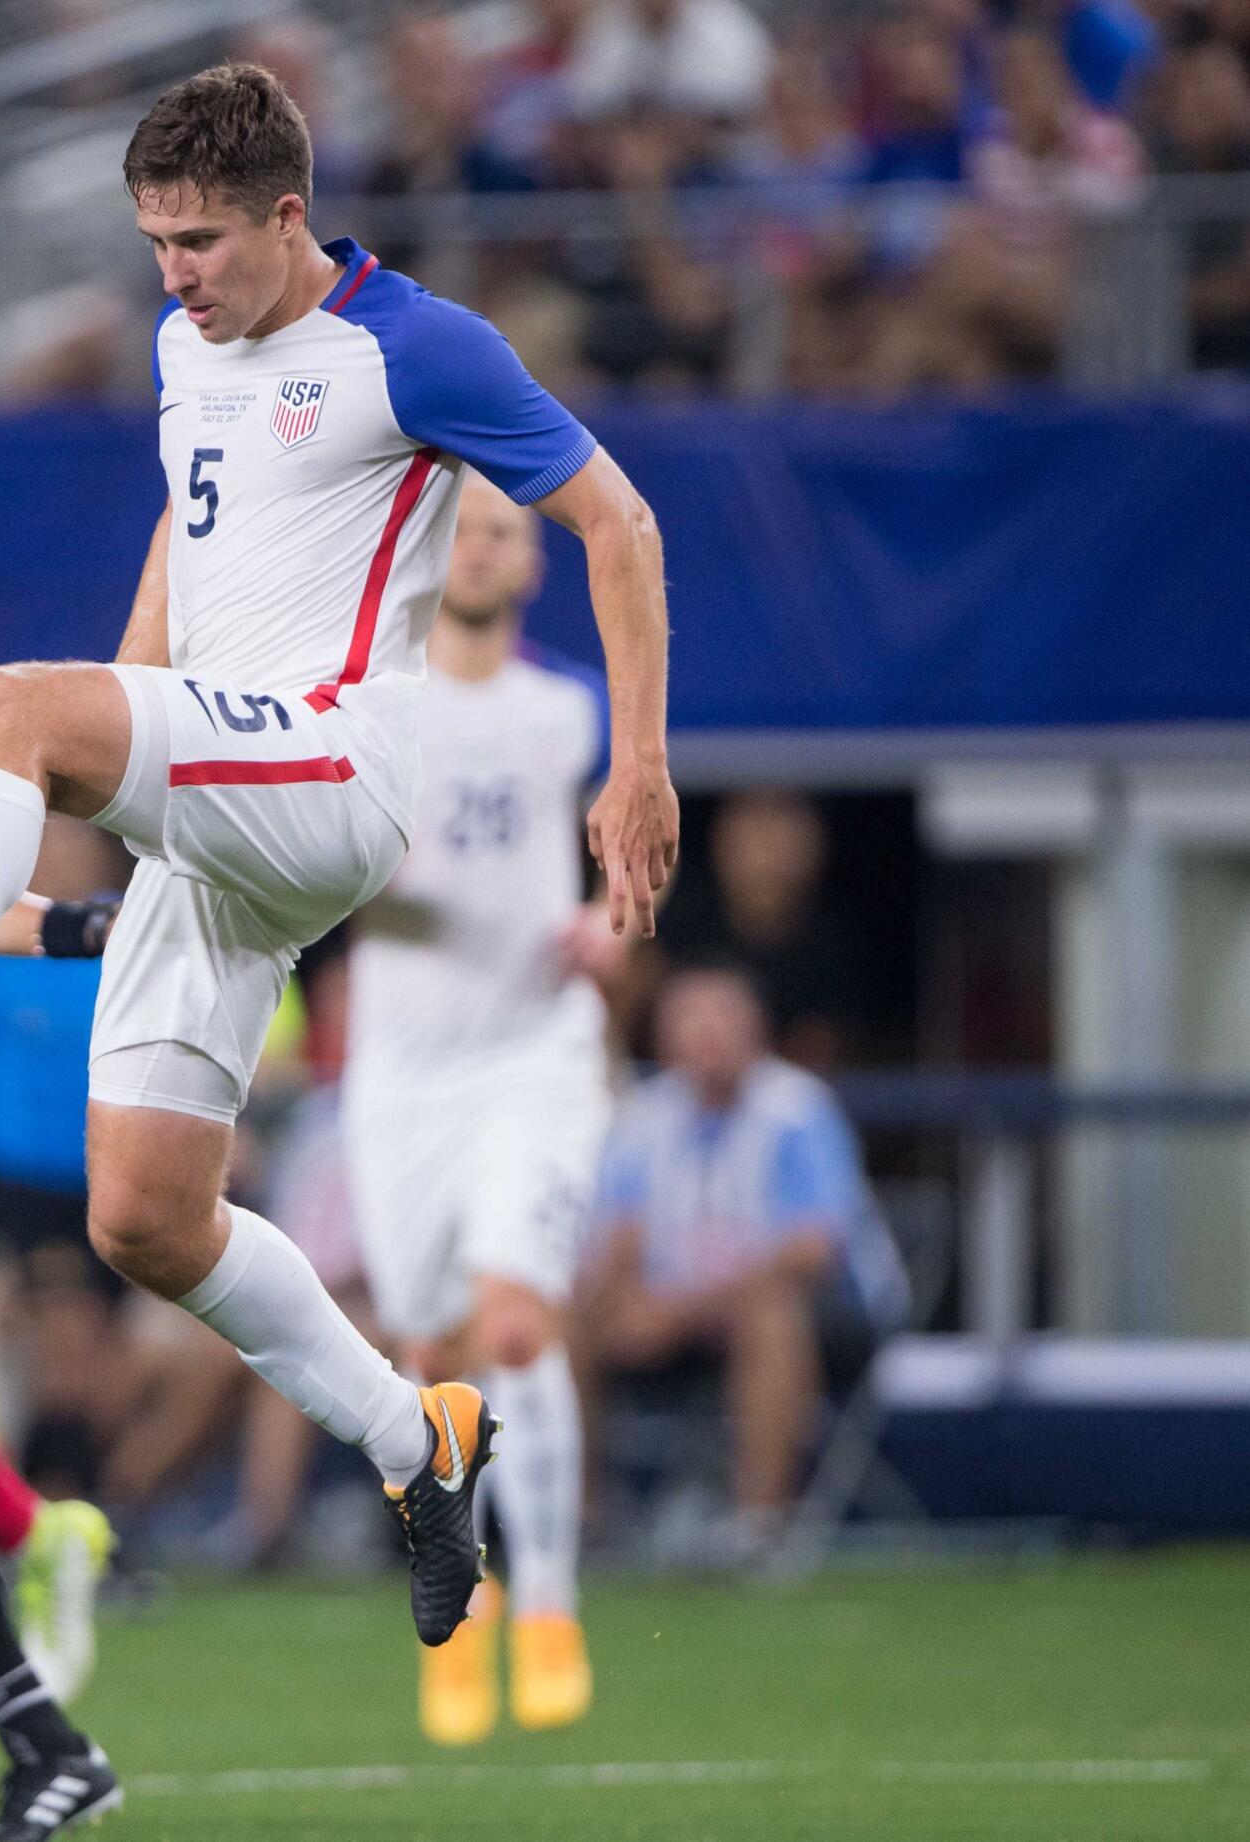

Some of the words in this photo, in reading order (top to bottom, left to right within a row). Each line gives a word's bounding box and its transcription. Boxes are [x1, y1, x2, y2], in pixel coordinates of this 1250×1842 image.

[281, 380, 323, 407] USA
[187, 447, 224, 539] 5
[213, 690, 293, 733] 5
